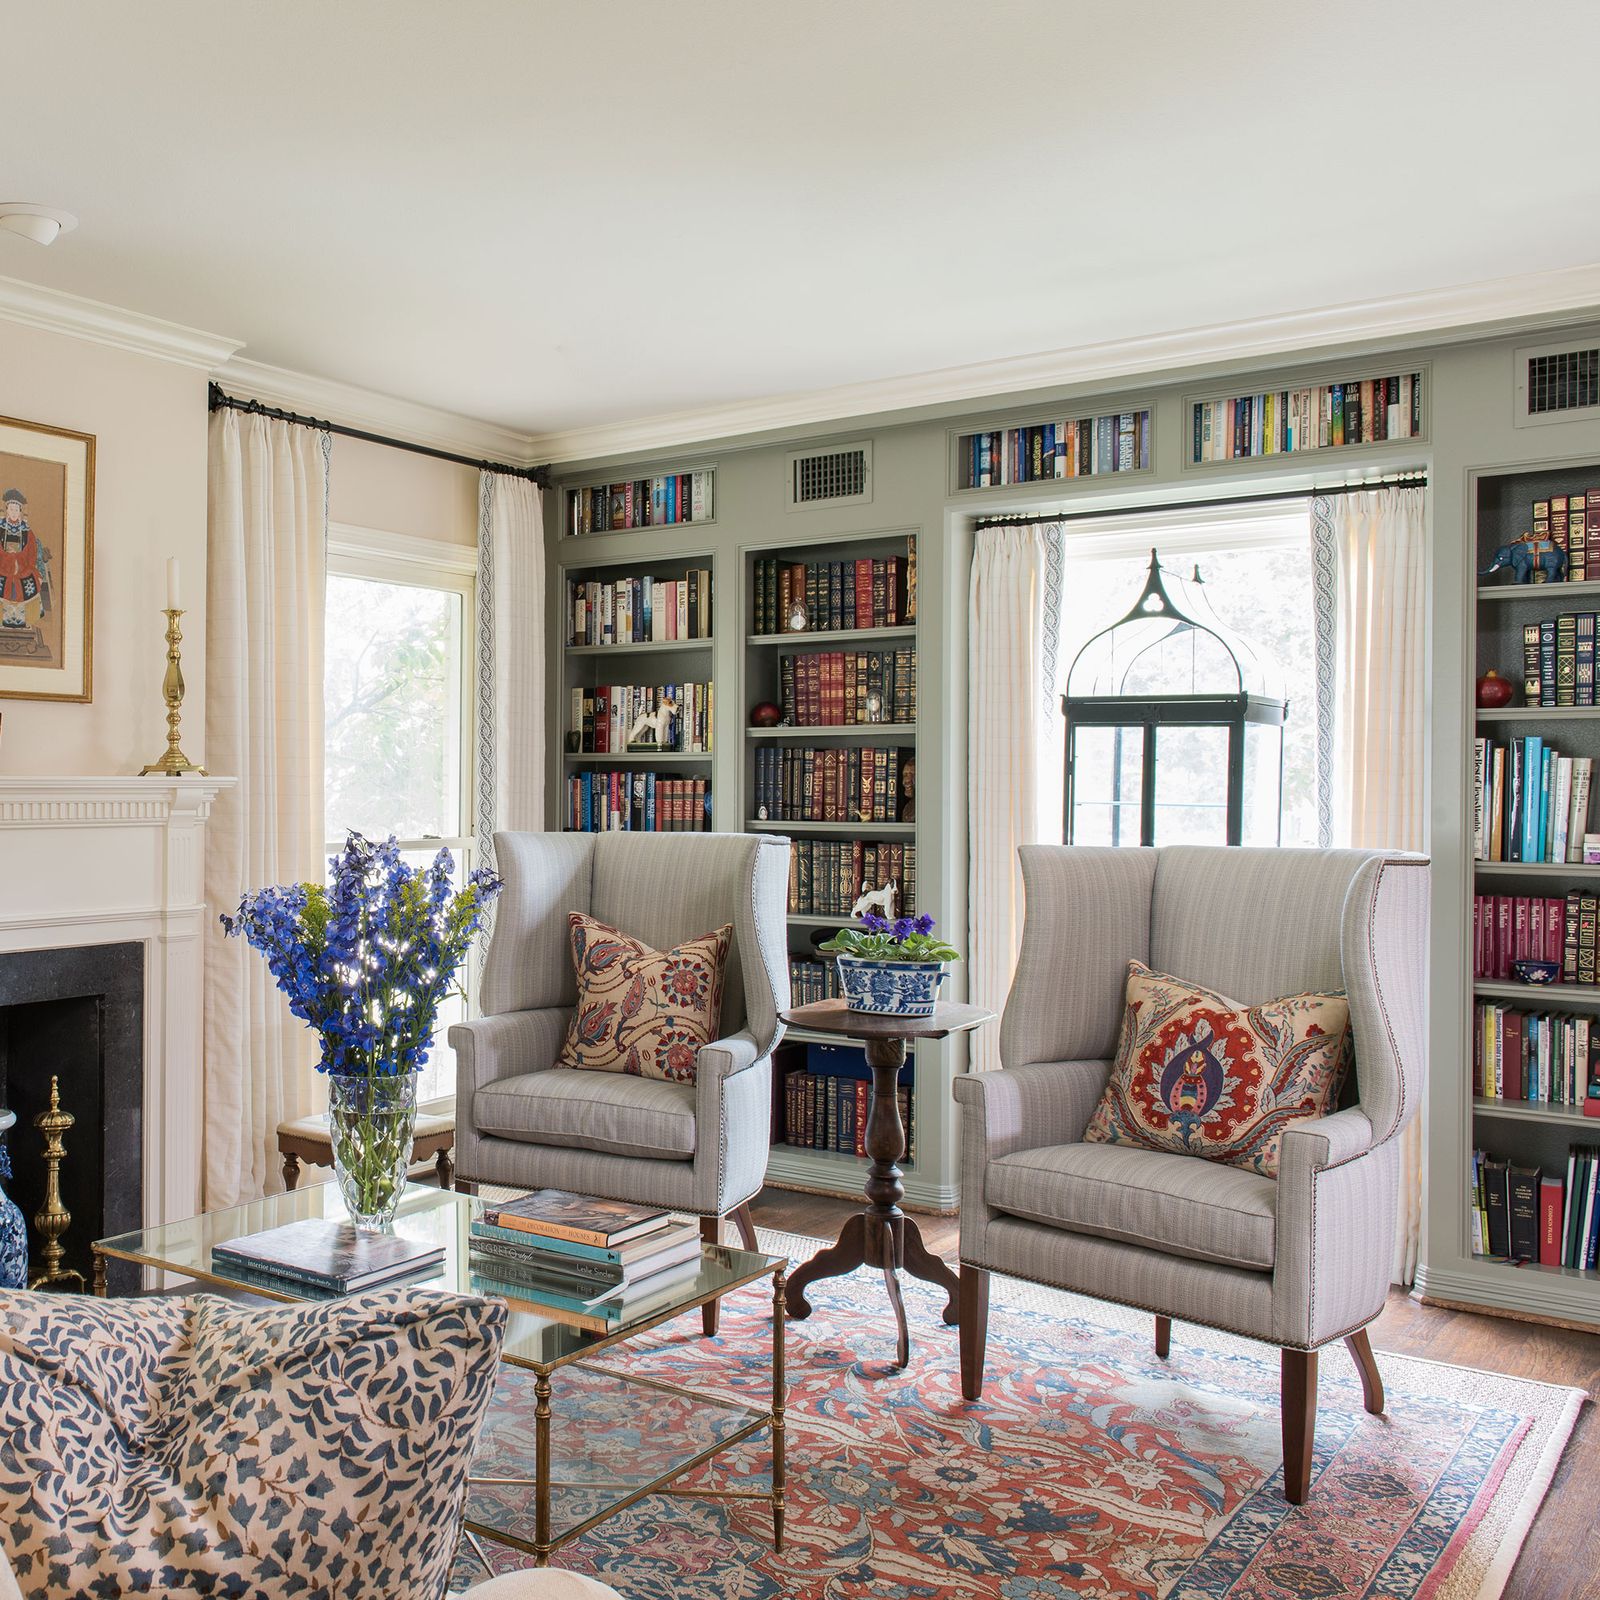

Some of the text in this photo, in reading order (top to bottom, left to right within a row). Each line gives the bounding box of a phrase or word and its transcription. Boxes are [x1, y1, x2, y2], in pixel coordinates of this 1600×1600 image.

[1475, 743, 1483, 758] The
[1475, 758, 1483, 772] Best
[1475, 773, 1483, 784] of
[1475, 784, 1483, 804] Texas
[1549, 906, 1558, 918] Mark
[1549, 918, 1558, 931] Twain
[475, 1241, 517, 1259] SEGRETO
[247, 1259, 269, 1272] interior
[269, 1263, 303, 1280] inspirations
